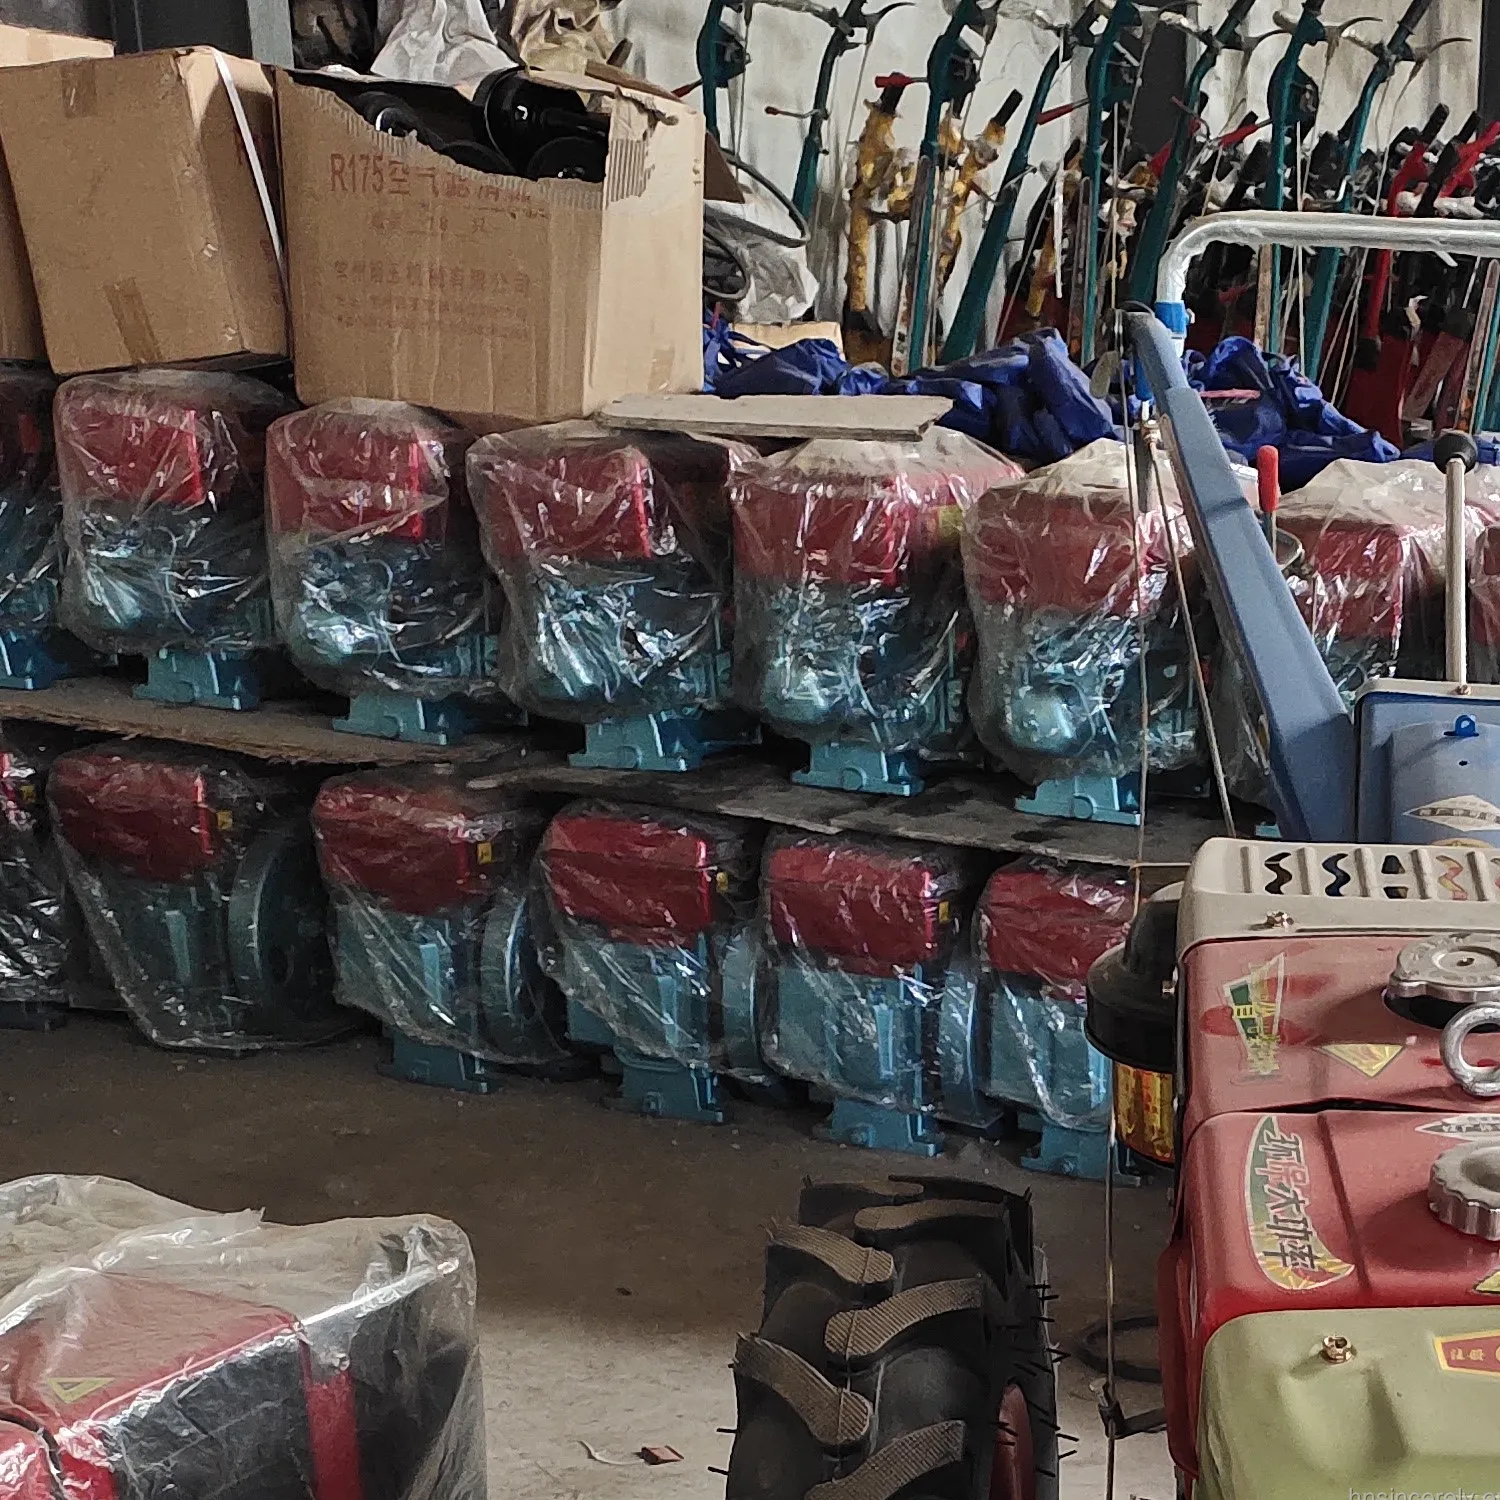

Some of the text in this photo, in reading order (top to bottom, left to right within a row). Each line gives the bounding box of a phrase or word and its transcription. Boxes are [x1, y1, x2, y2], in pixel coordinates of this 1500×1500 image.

[1255, 1130, 1318, 1271] 环保大功率
